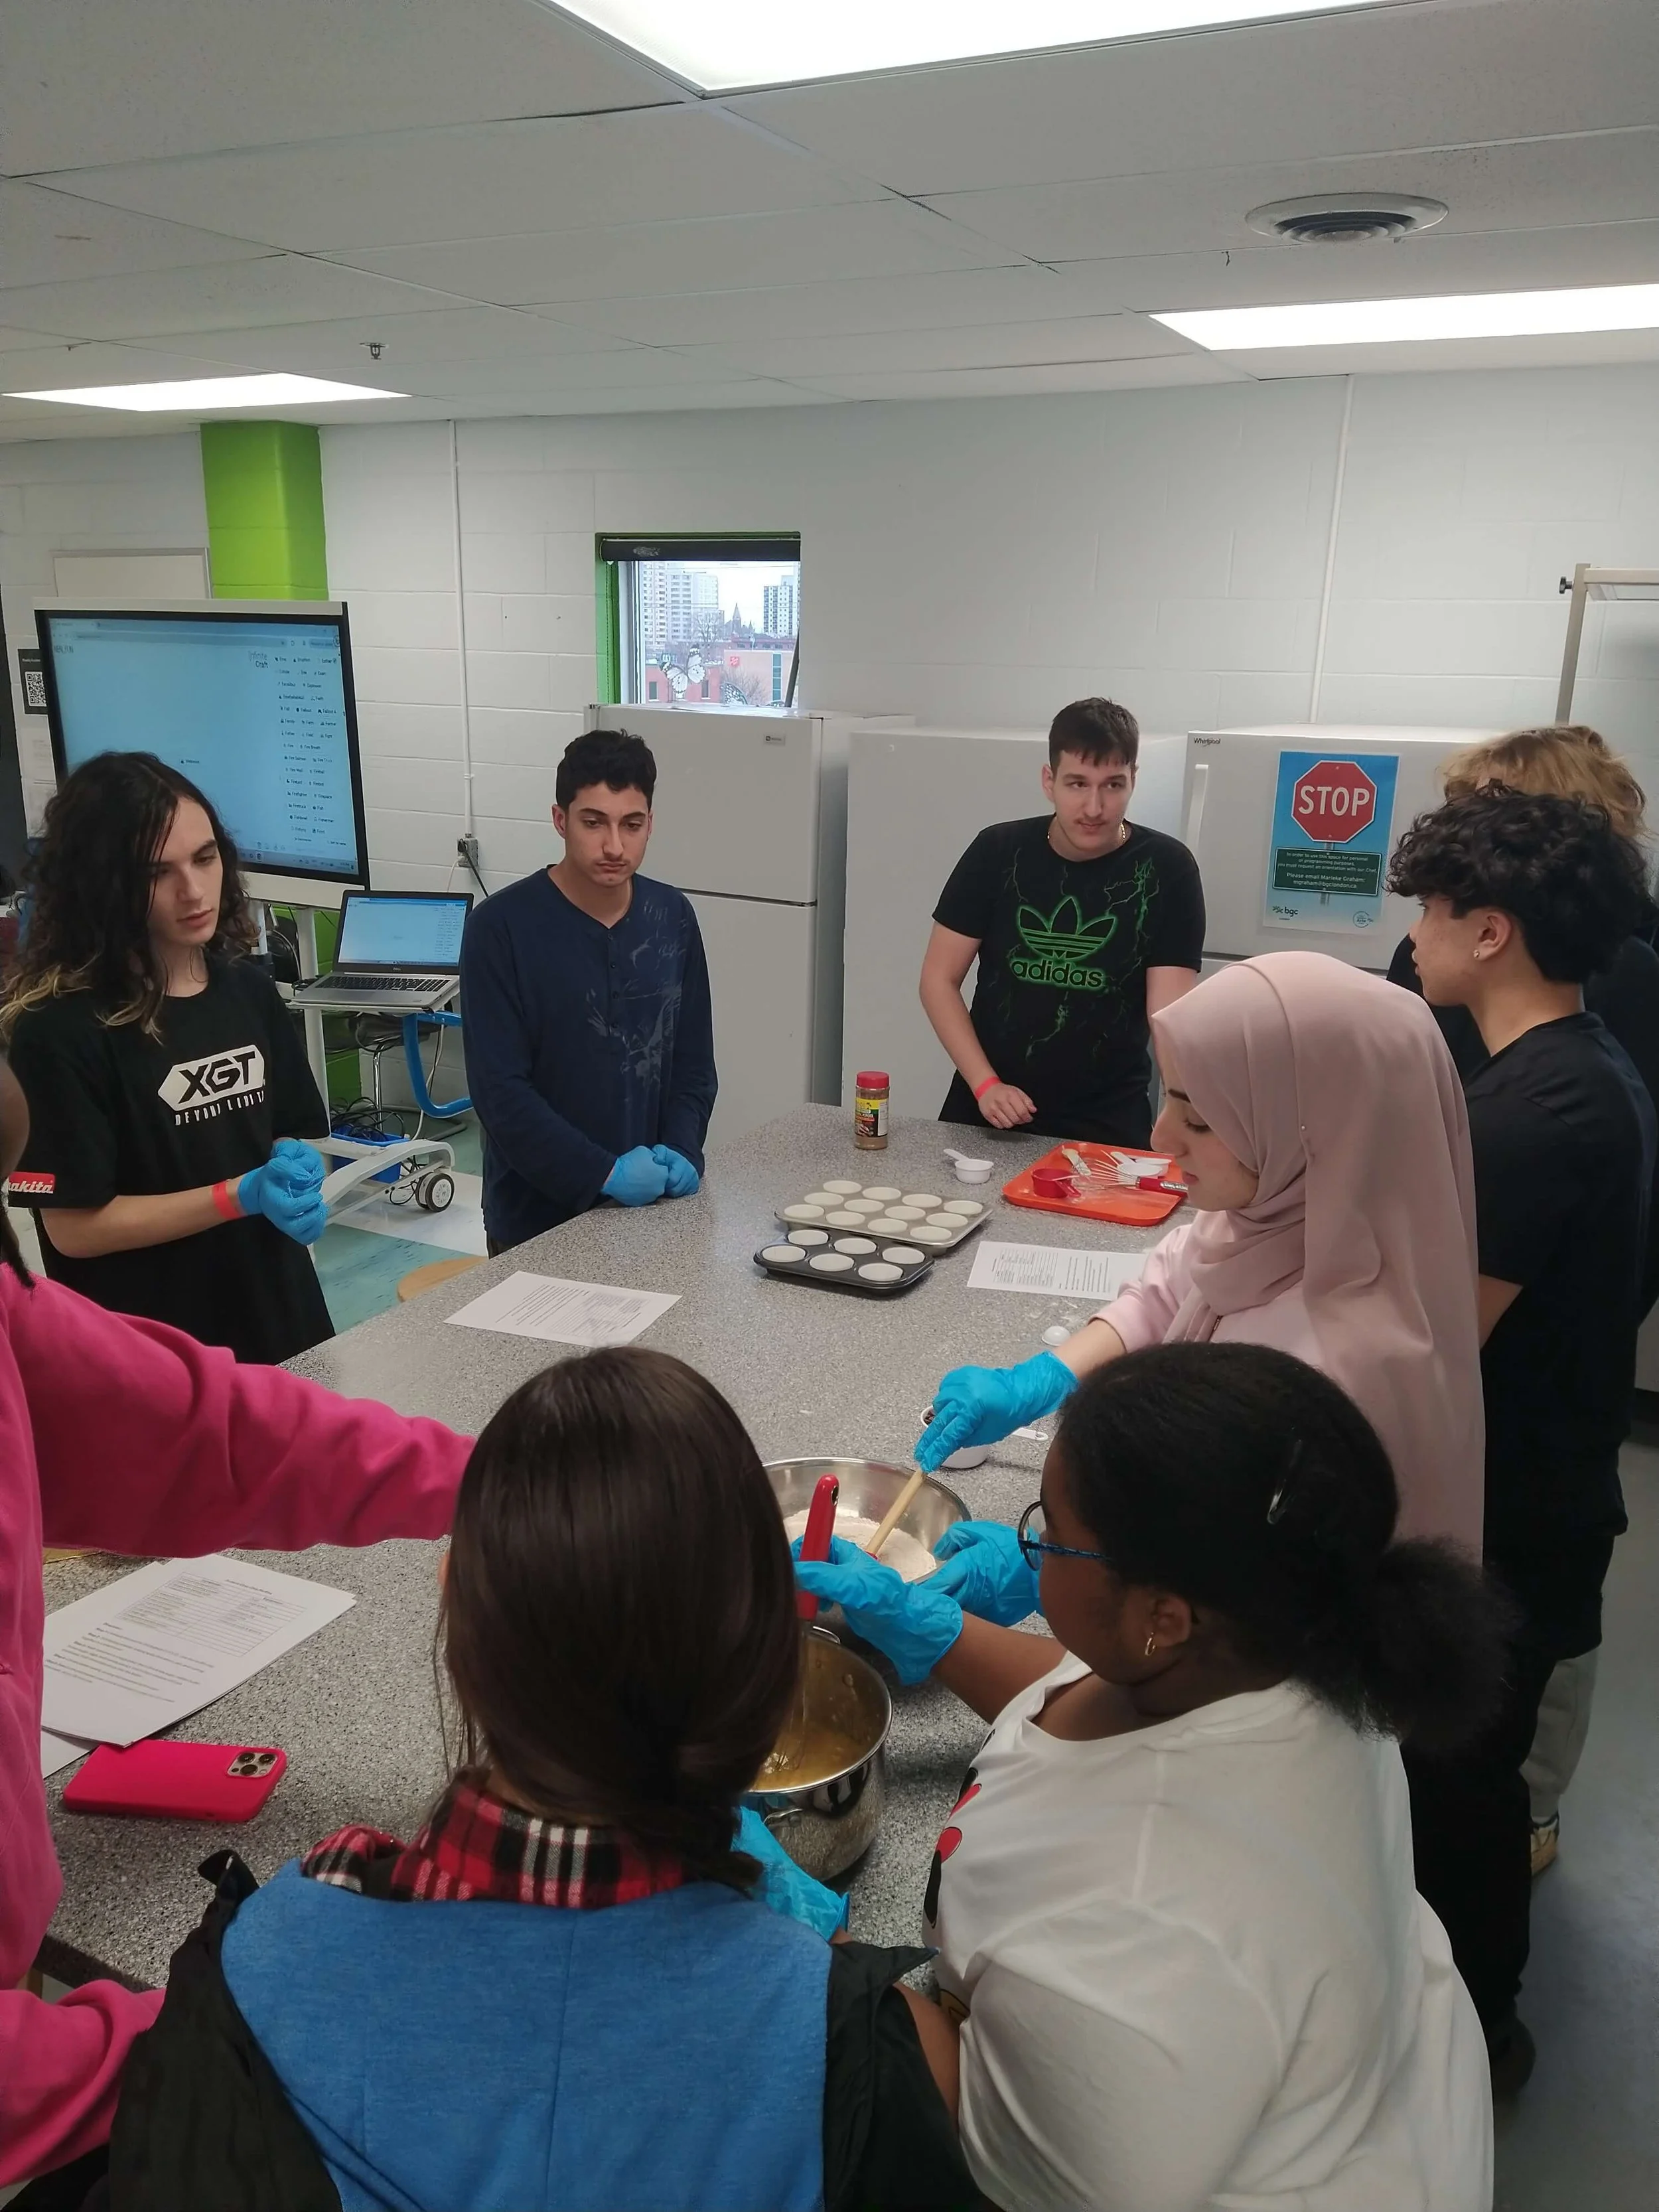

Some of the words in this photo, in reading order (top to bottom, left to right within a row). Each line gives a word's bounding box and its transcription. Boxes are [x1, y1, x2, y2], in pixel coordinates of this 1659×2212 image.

[1194, 737, 1221, 746] Whirlpool
[1299, 785, 1370, 816] STOP
[1284, 907, 1299, 917] bgc
[1011, 960, 1103, 988] adidas
[178, 1051, 256, 1104] XGT
